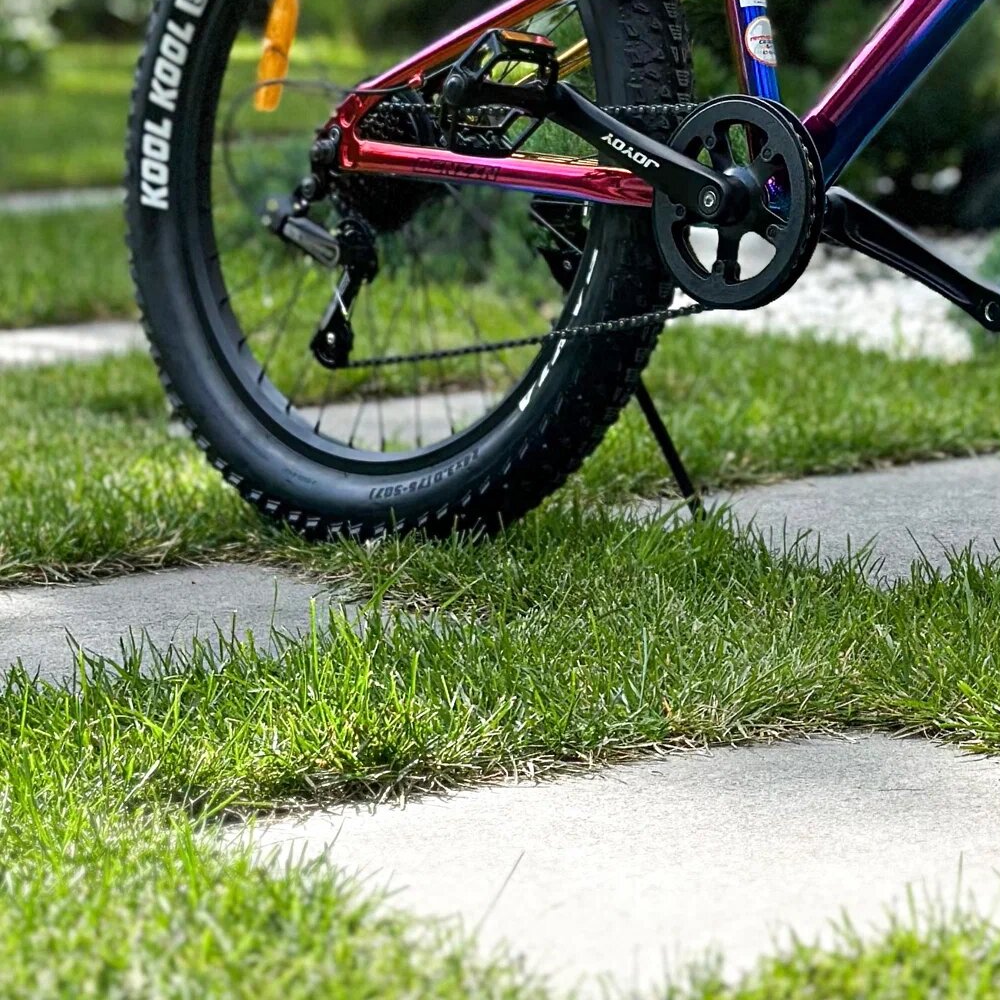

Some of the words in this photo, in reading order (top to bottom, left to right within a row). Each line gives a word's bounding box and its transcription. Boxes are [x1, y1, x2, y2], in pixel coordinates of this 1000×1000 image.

[148, 19, 196, 112] KOOL
[140, 117, 173, 211] KOOL
[600, 132, 660, 168] JOYOY
